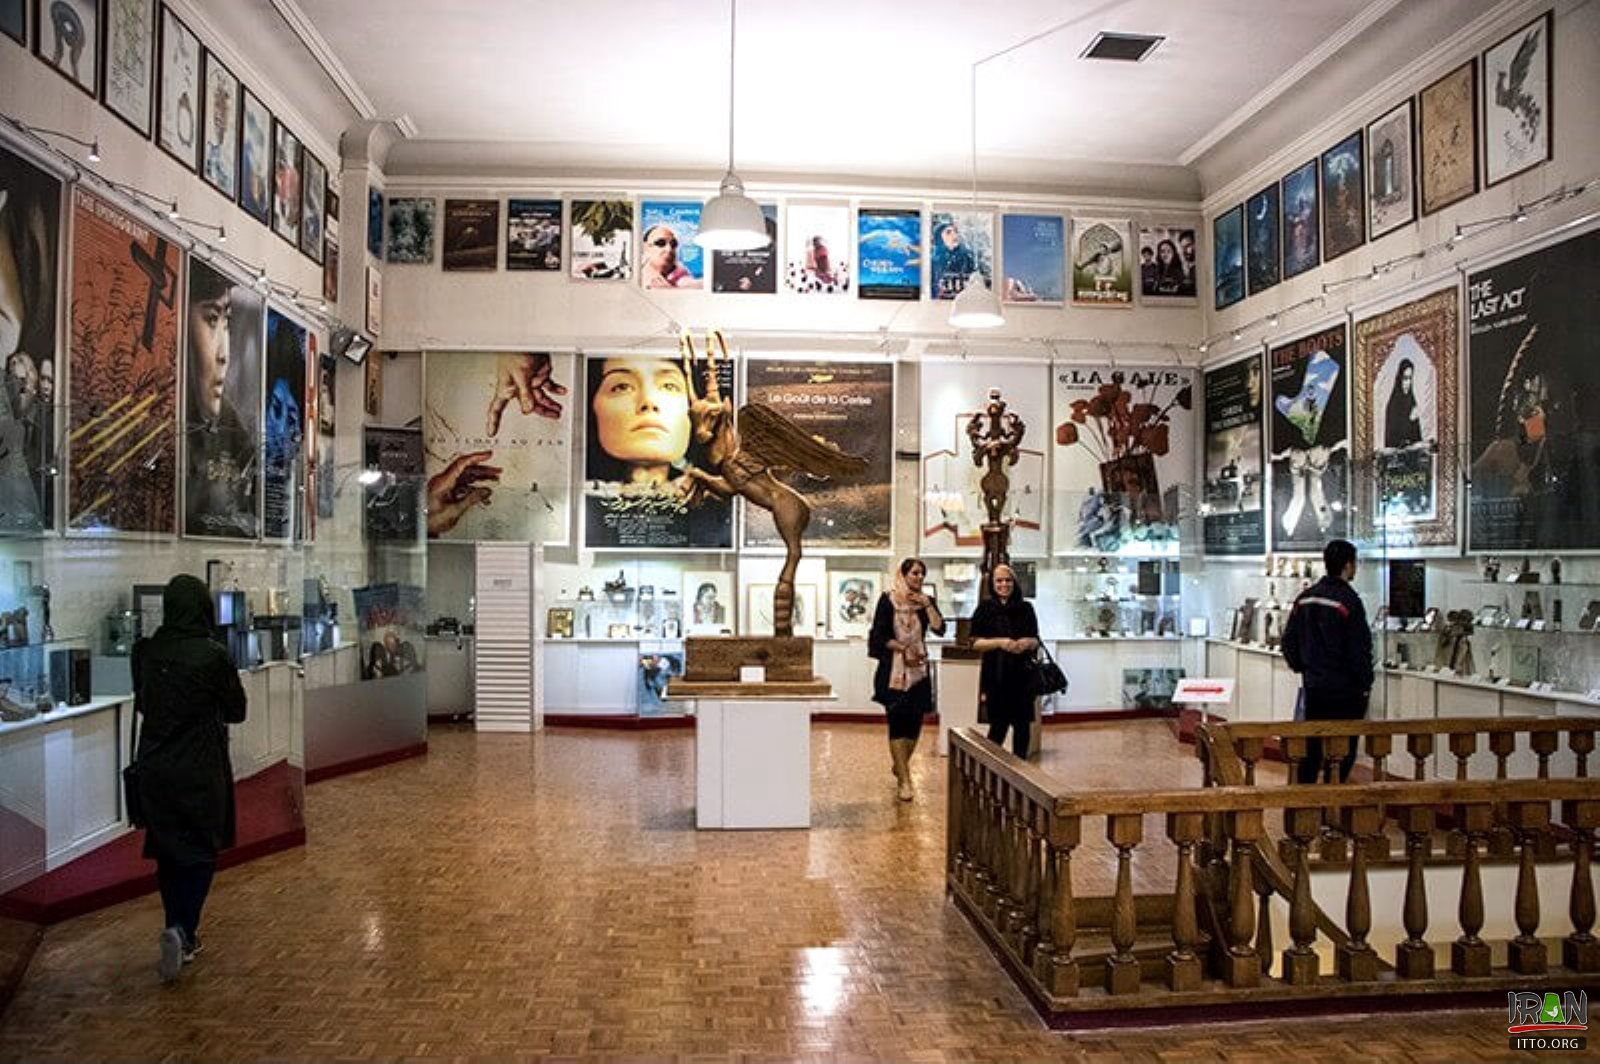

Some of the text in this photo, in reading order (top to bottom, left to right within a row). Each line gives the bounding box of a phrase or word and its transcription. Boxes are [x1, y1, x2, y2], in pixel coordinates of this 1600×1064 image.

[1470, 279, 1493, 301] THE
[1471, 287, 1526, 320] LAST ACT
[811, 393, 827, 404] de
